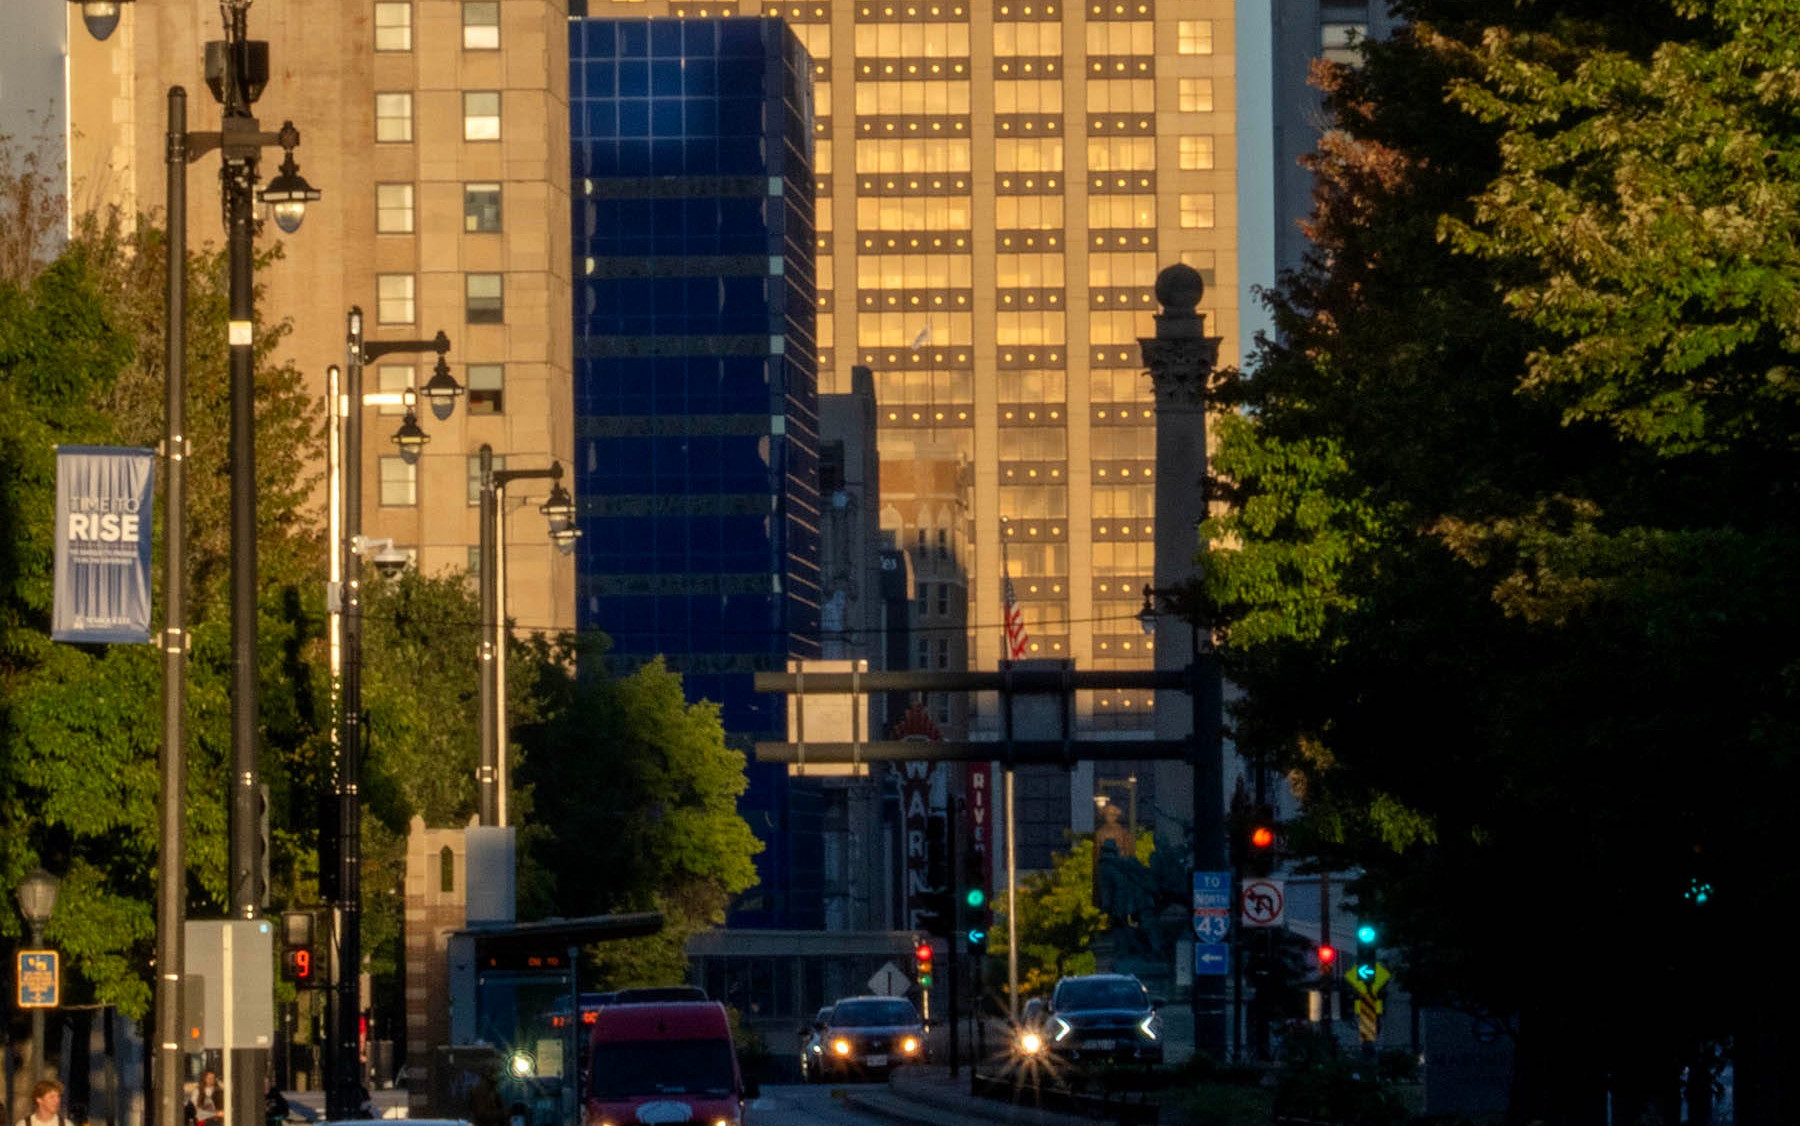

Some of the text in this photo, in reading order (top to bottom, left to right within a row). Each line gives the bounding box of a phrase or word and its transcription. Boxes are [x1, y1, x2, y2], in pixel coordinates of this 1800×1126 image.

[116, 497, 140, 514] TO
[68, 513, 140, 542] RISE
[1203, 876, 1221, 888] TO
[1195, 894, 1227, 905] NORTH
[1197, 916, 1226, 936] 43
[296, 949, 310, 977] 9
